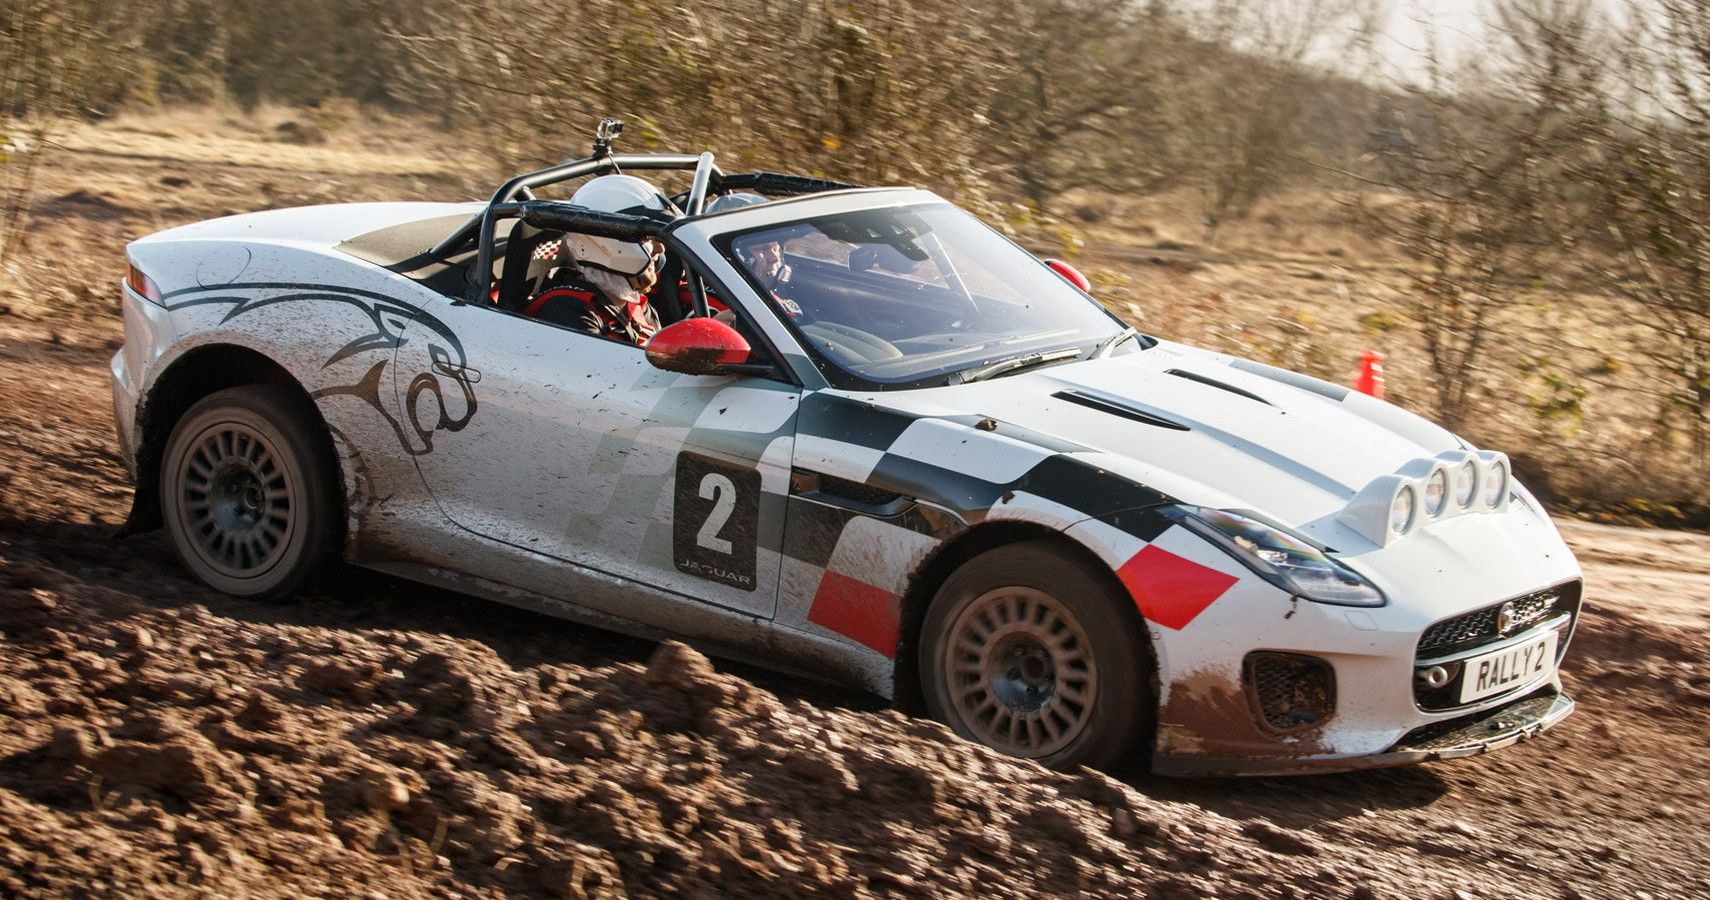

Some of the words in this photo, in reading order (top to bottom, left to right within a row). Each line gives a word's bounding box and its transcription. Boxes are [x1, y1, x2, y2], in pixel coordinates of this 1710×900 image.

[696, 472, 737, 555] 2
[680, 559, 751, 585] JAGUAR
[1476, 645, 1534, 692] RALLY
[1534, 641, 1546, 672] 2
